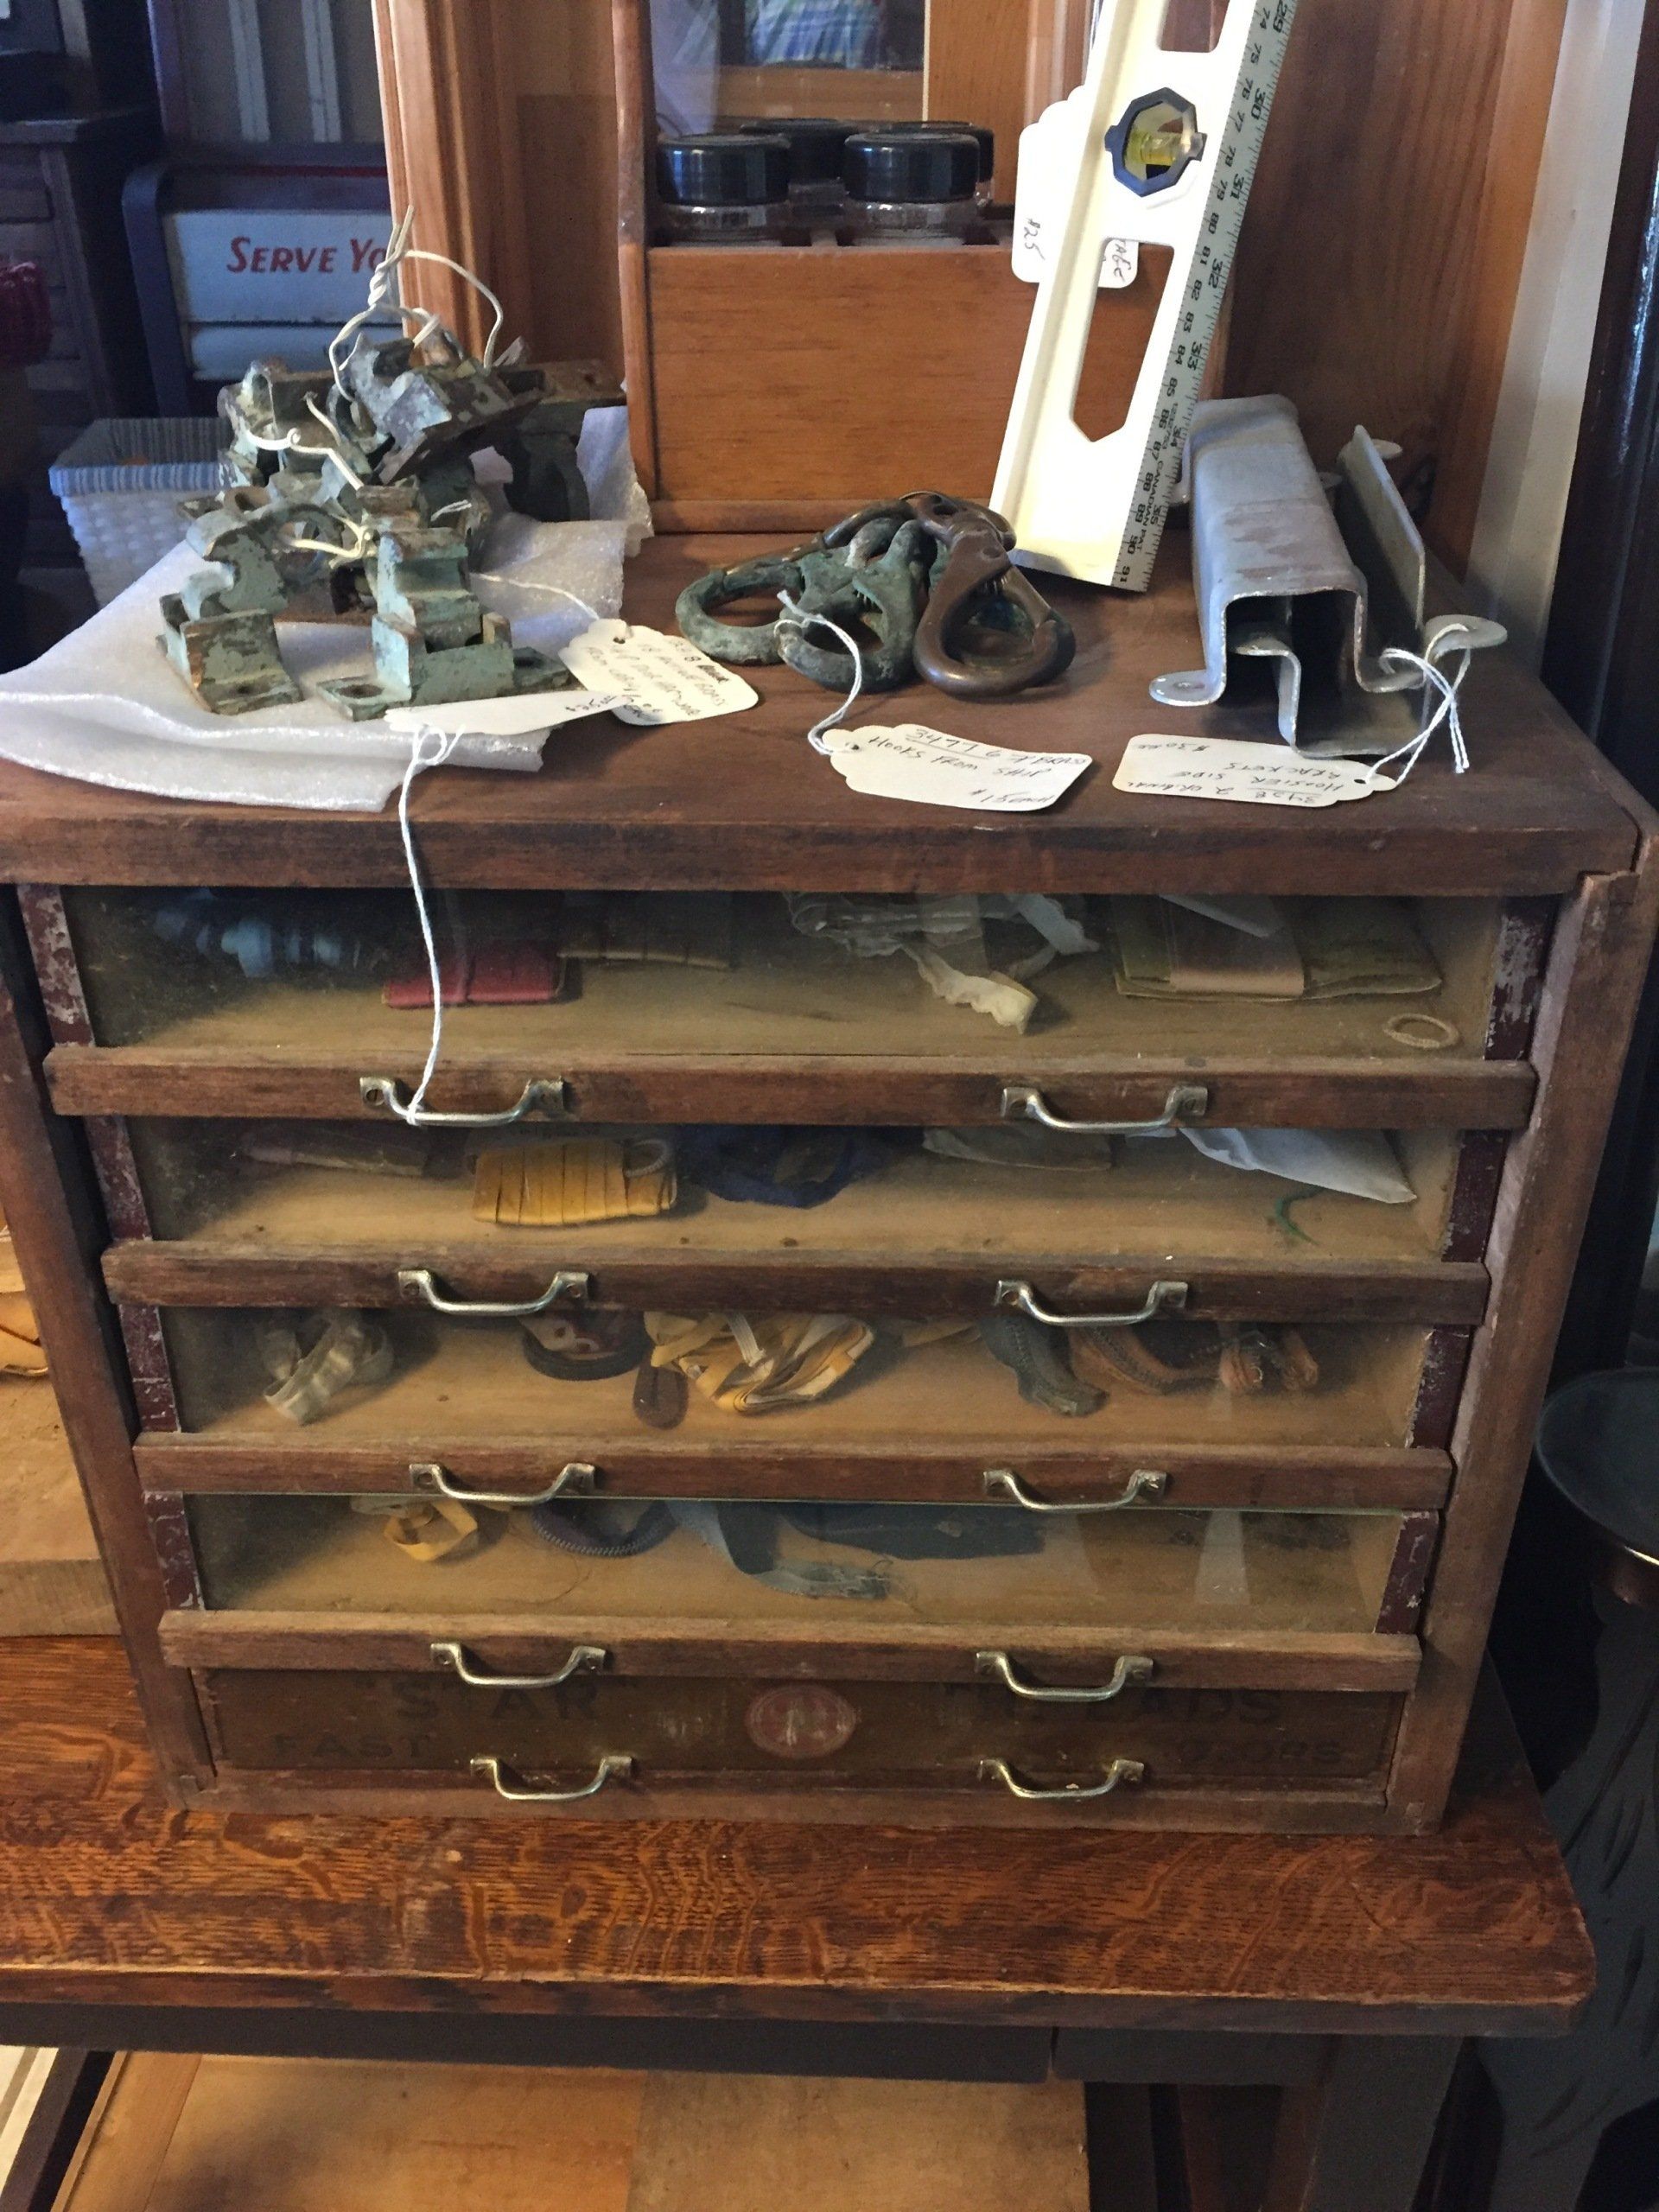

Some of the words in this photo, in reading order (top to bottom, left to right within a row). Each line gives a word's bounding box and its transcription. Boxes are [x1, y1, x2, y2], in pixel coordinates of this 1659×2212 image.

[1259, 7, 1270, 29] 74
[1273, 0, 1287, 33] 29
[1250, 42, 1262, 64] 75
[1251, 87, 1266, 120] 30
[1234, 111, 1245, 133] 77
[1225, 145, 1236, 168] 78
[1217, 179, 1228, 201] 79
[1230, 173, 1245, 200] 31
[1208, 212, 1219, 235] 80
[226, 236, 338, 273] SERVE
[1200, 245, 1211, 266] 81
[1208, 257, 1224, 289] 32
[1191, 279, 1203, 302] 82
[1183, 311, 1194, 334] 83
[1175, 345, 1185, 365] 84
[1187, 341, 1203, 371] 33
[1166, 377, 1179, 397] 85
[1159, 408, 1170, 429] 86
[1151, 441, 1161, 461] 87
[1142, 472, 1154, 493] 88
[1143, 460, 1164, 526] CANADIAN
[1135, 503, 1146, 524] 89
[1150, 505, 1161, 525] 35
[1127, 535, 1136, 555] 90
[1136, 529, 1147, 553] PAT
[1120, 565, 1130, 582] 91
